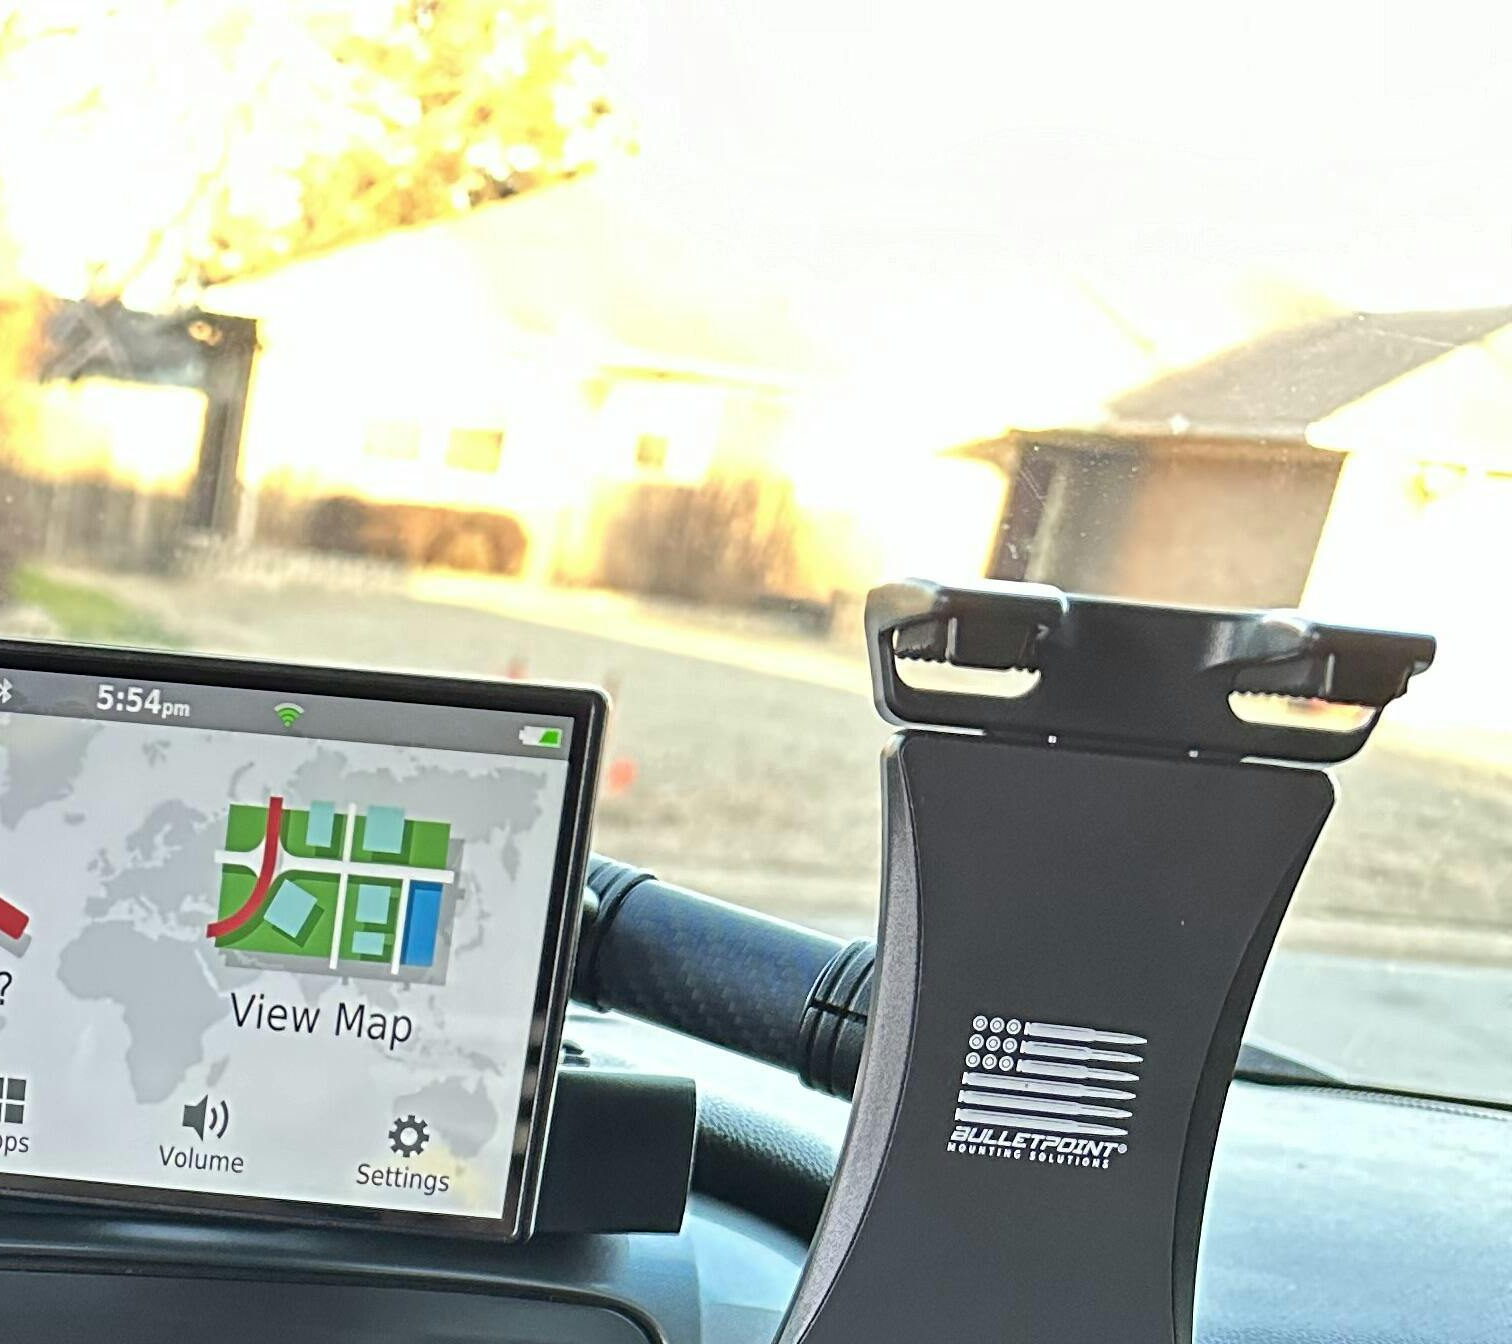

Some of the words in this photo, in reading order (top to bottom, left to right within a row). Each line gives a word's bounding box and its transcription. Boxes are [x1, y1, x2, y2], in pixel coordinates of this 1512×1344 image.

[231, 992, 321, 1034] View
[335, 1002, 413, 1051] Map
[159, 1145, 245, 1173] Volume
[946, 1141, 1022, 1160] MOUNTING
[1029, 1151, 1110, 1169] SOLUTIONS
[356, 1163, 450, 1195] Settings
